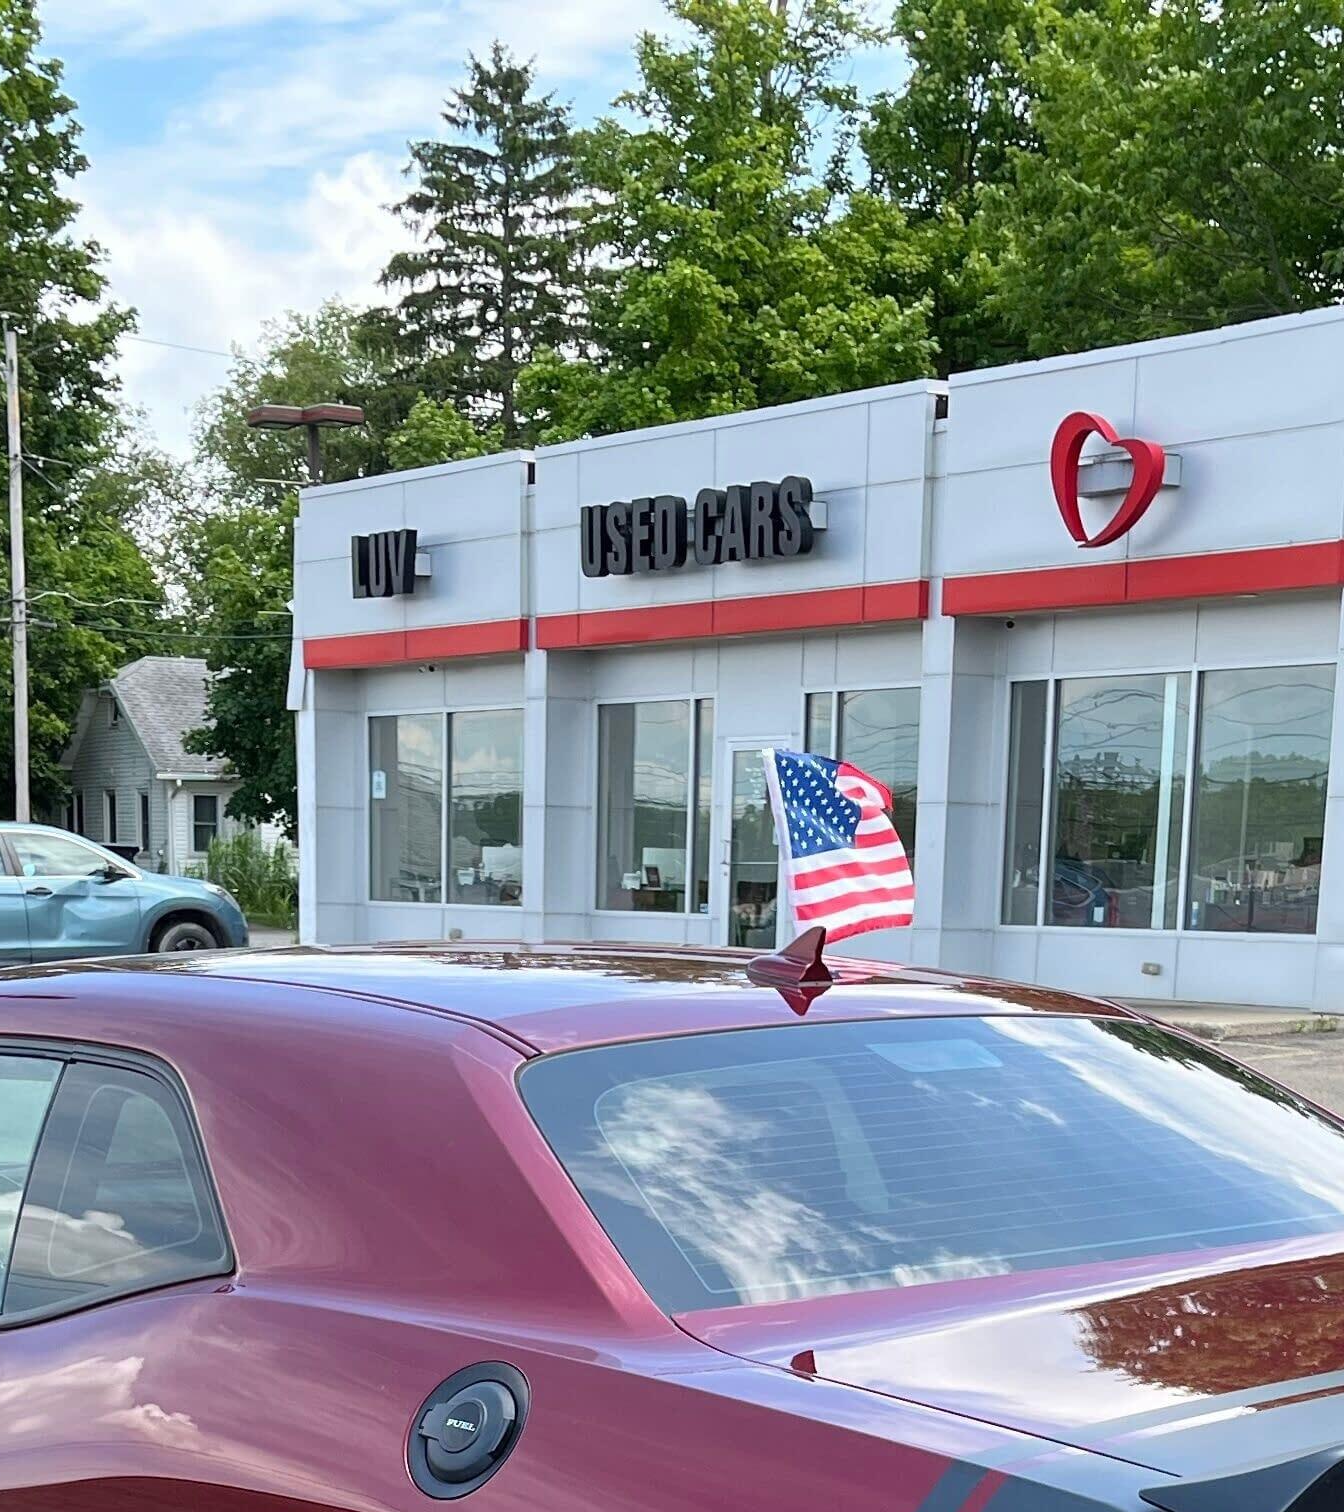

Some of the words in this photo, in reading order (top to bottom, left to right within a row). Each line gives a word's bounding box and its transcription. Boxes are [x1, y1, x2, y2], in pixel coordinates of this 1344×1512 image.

[581, 495, 687, 577] USED
[694, 476, 814, 565] CARS
[351, 528, 417, 599] LUV
[446, 1418, 476, 1432] FUEL
